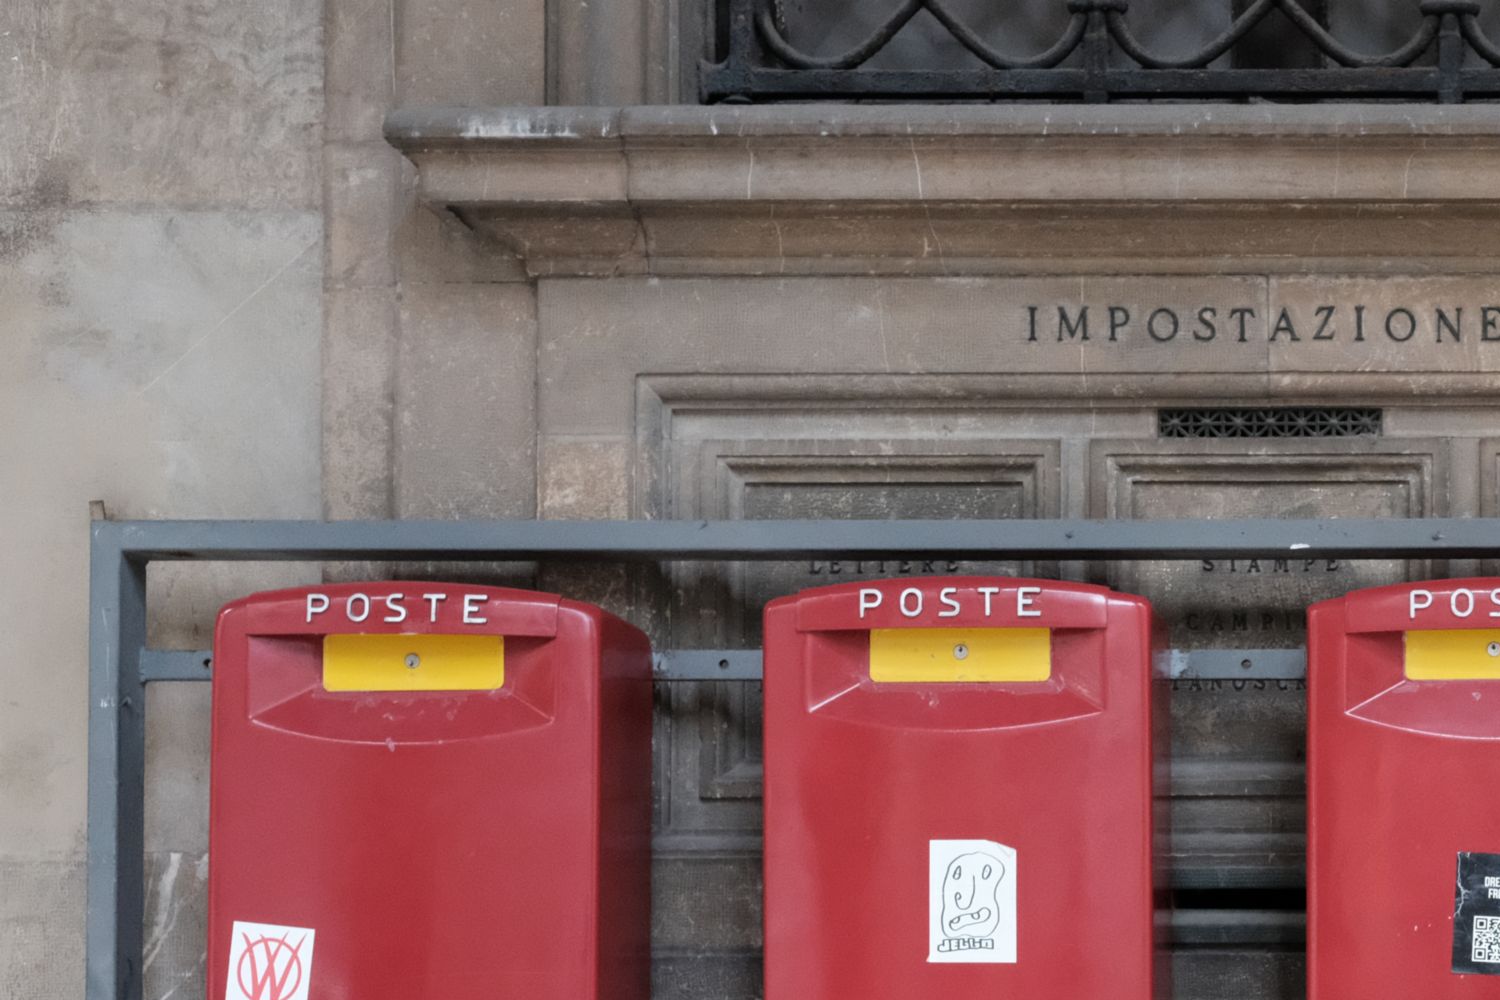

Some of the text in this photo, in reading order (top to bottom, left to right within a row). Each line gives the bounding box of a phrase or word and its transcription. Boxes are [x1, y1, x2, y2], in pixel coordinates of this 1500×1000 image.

[1202, 559, 1342, 573] STAMPE
[305, 593, 488, 623] POSTE
[859, 587, 1042, 618] POSTE
[1186, 612, 1306, 631] CAMPI
